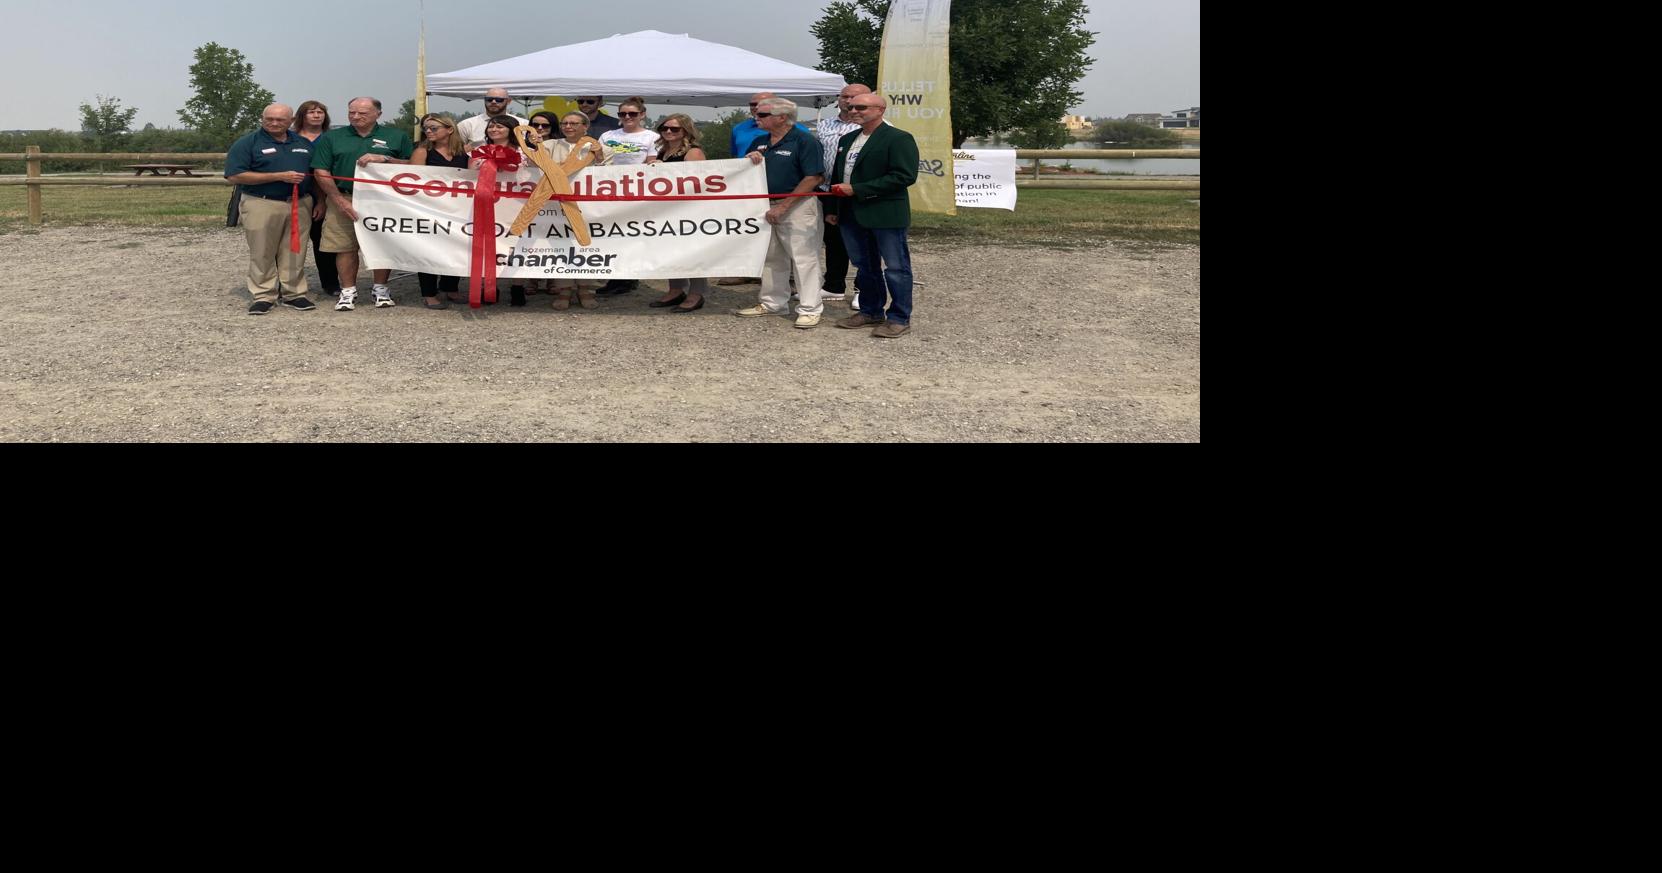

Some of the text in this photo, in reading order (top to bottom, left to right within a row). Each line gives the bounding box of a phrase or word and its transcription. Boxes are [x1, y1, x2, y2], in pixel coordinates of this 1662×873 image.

[362, 216, 451, 235] GREEN
[496, 246, 617, 267] chamber
[521, 246, 564, 254] bozeman
[543, 266, 612, 275] of Commerce
